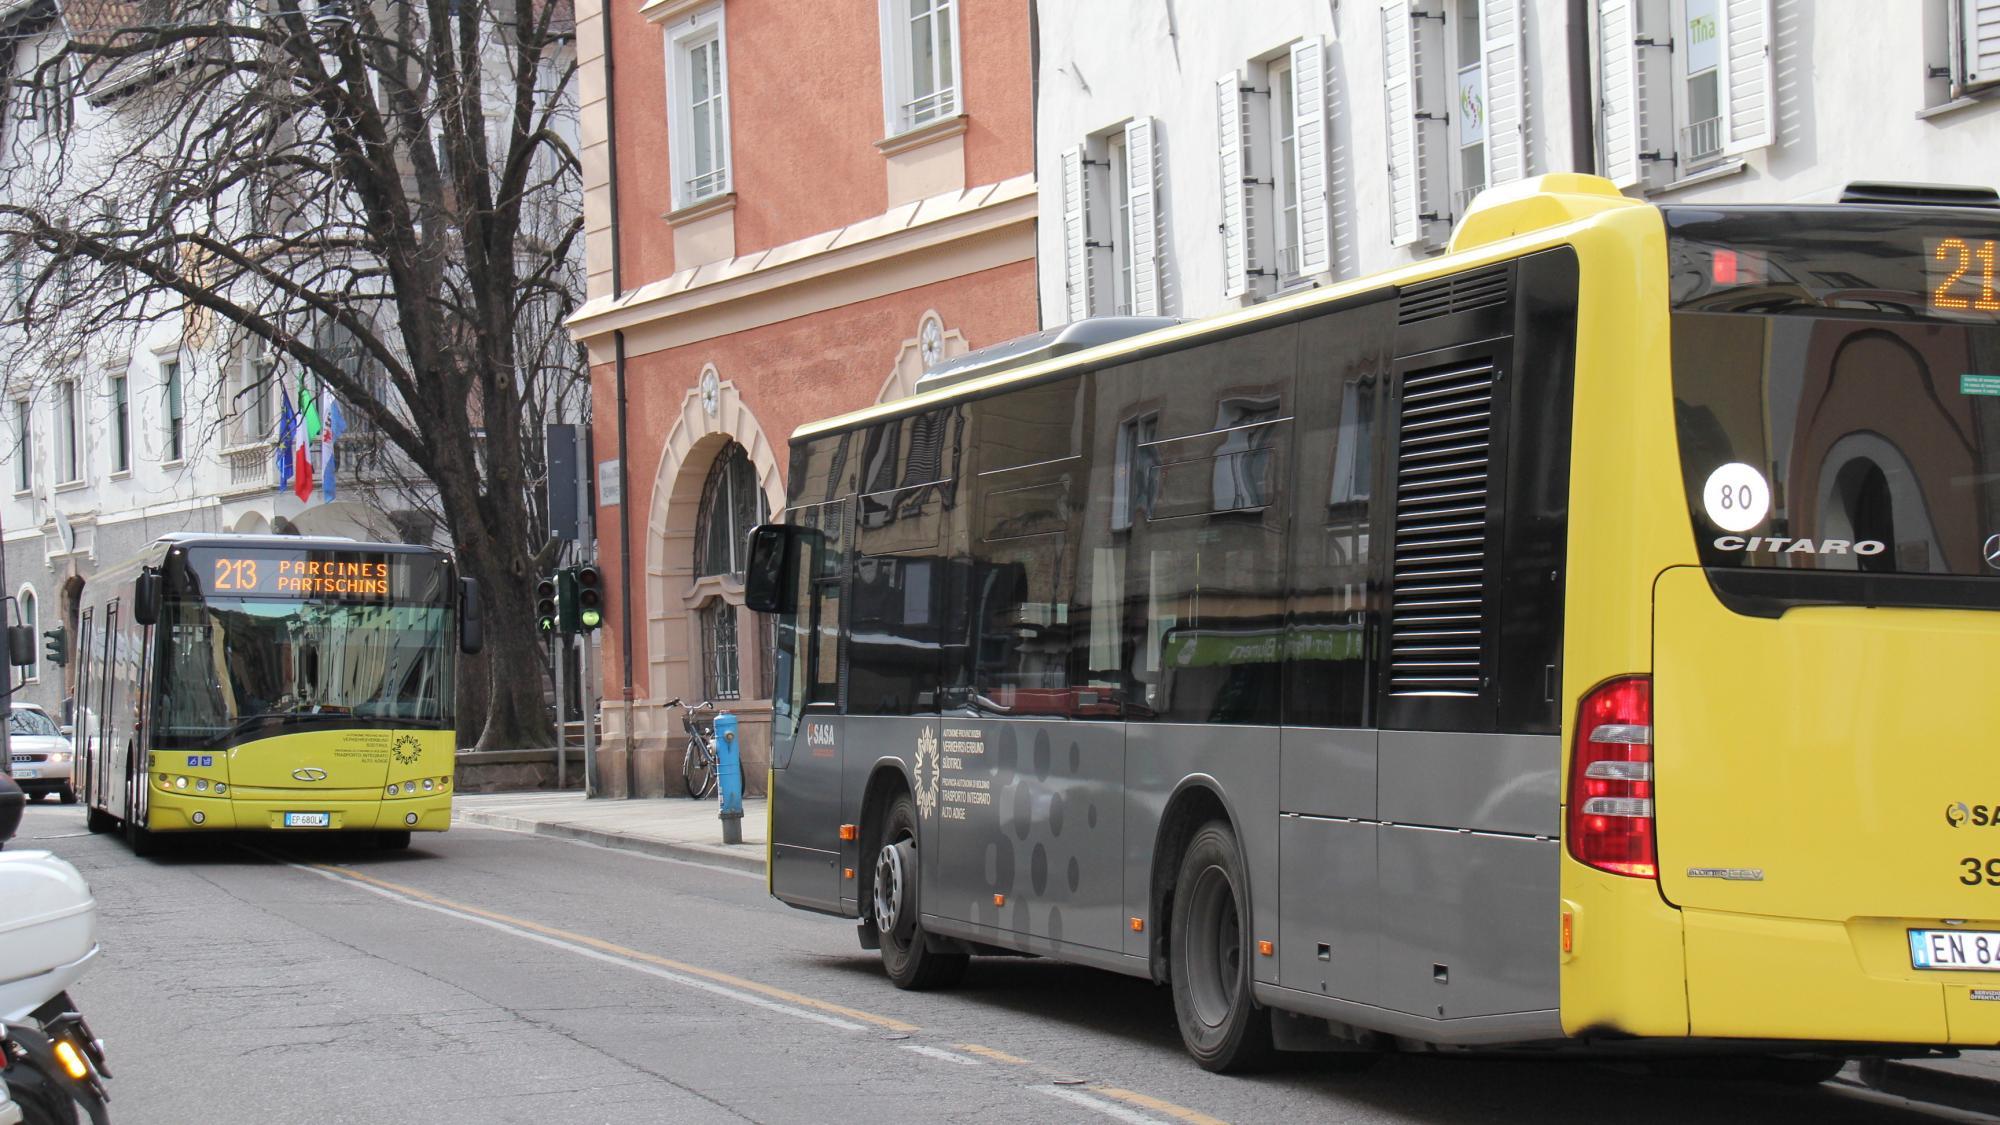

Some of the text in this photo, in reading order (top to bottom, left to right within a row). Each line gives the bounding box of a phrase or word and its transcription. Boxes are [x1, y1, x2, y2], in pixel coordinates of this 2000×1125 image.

[1721, 485, 1752, 510] 80
[1713, 536, 1885, 555] CITARO
[215, 559, 257, 589] 213
[280, 561, 388, 577] PARCINES
[278, 577, 388, 594] PARTSCHINS
[814, 724, 834, 745] SASA
[943, 741, 984, 753] VERKEHRSVERBUND
[942, 790, 991, 805] TRASPORTO INTEGRATO
[942, 806, 966, 819] ALTO ADIGE
[1931, 935, 1966, 963] EN
